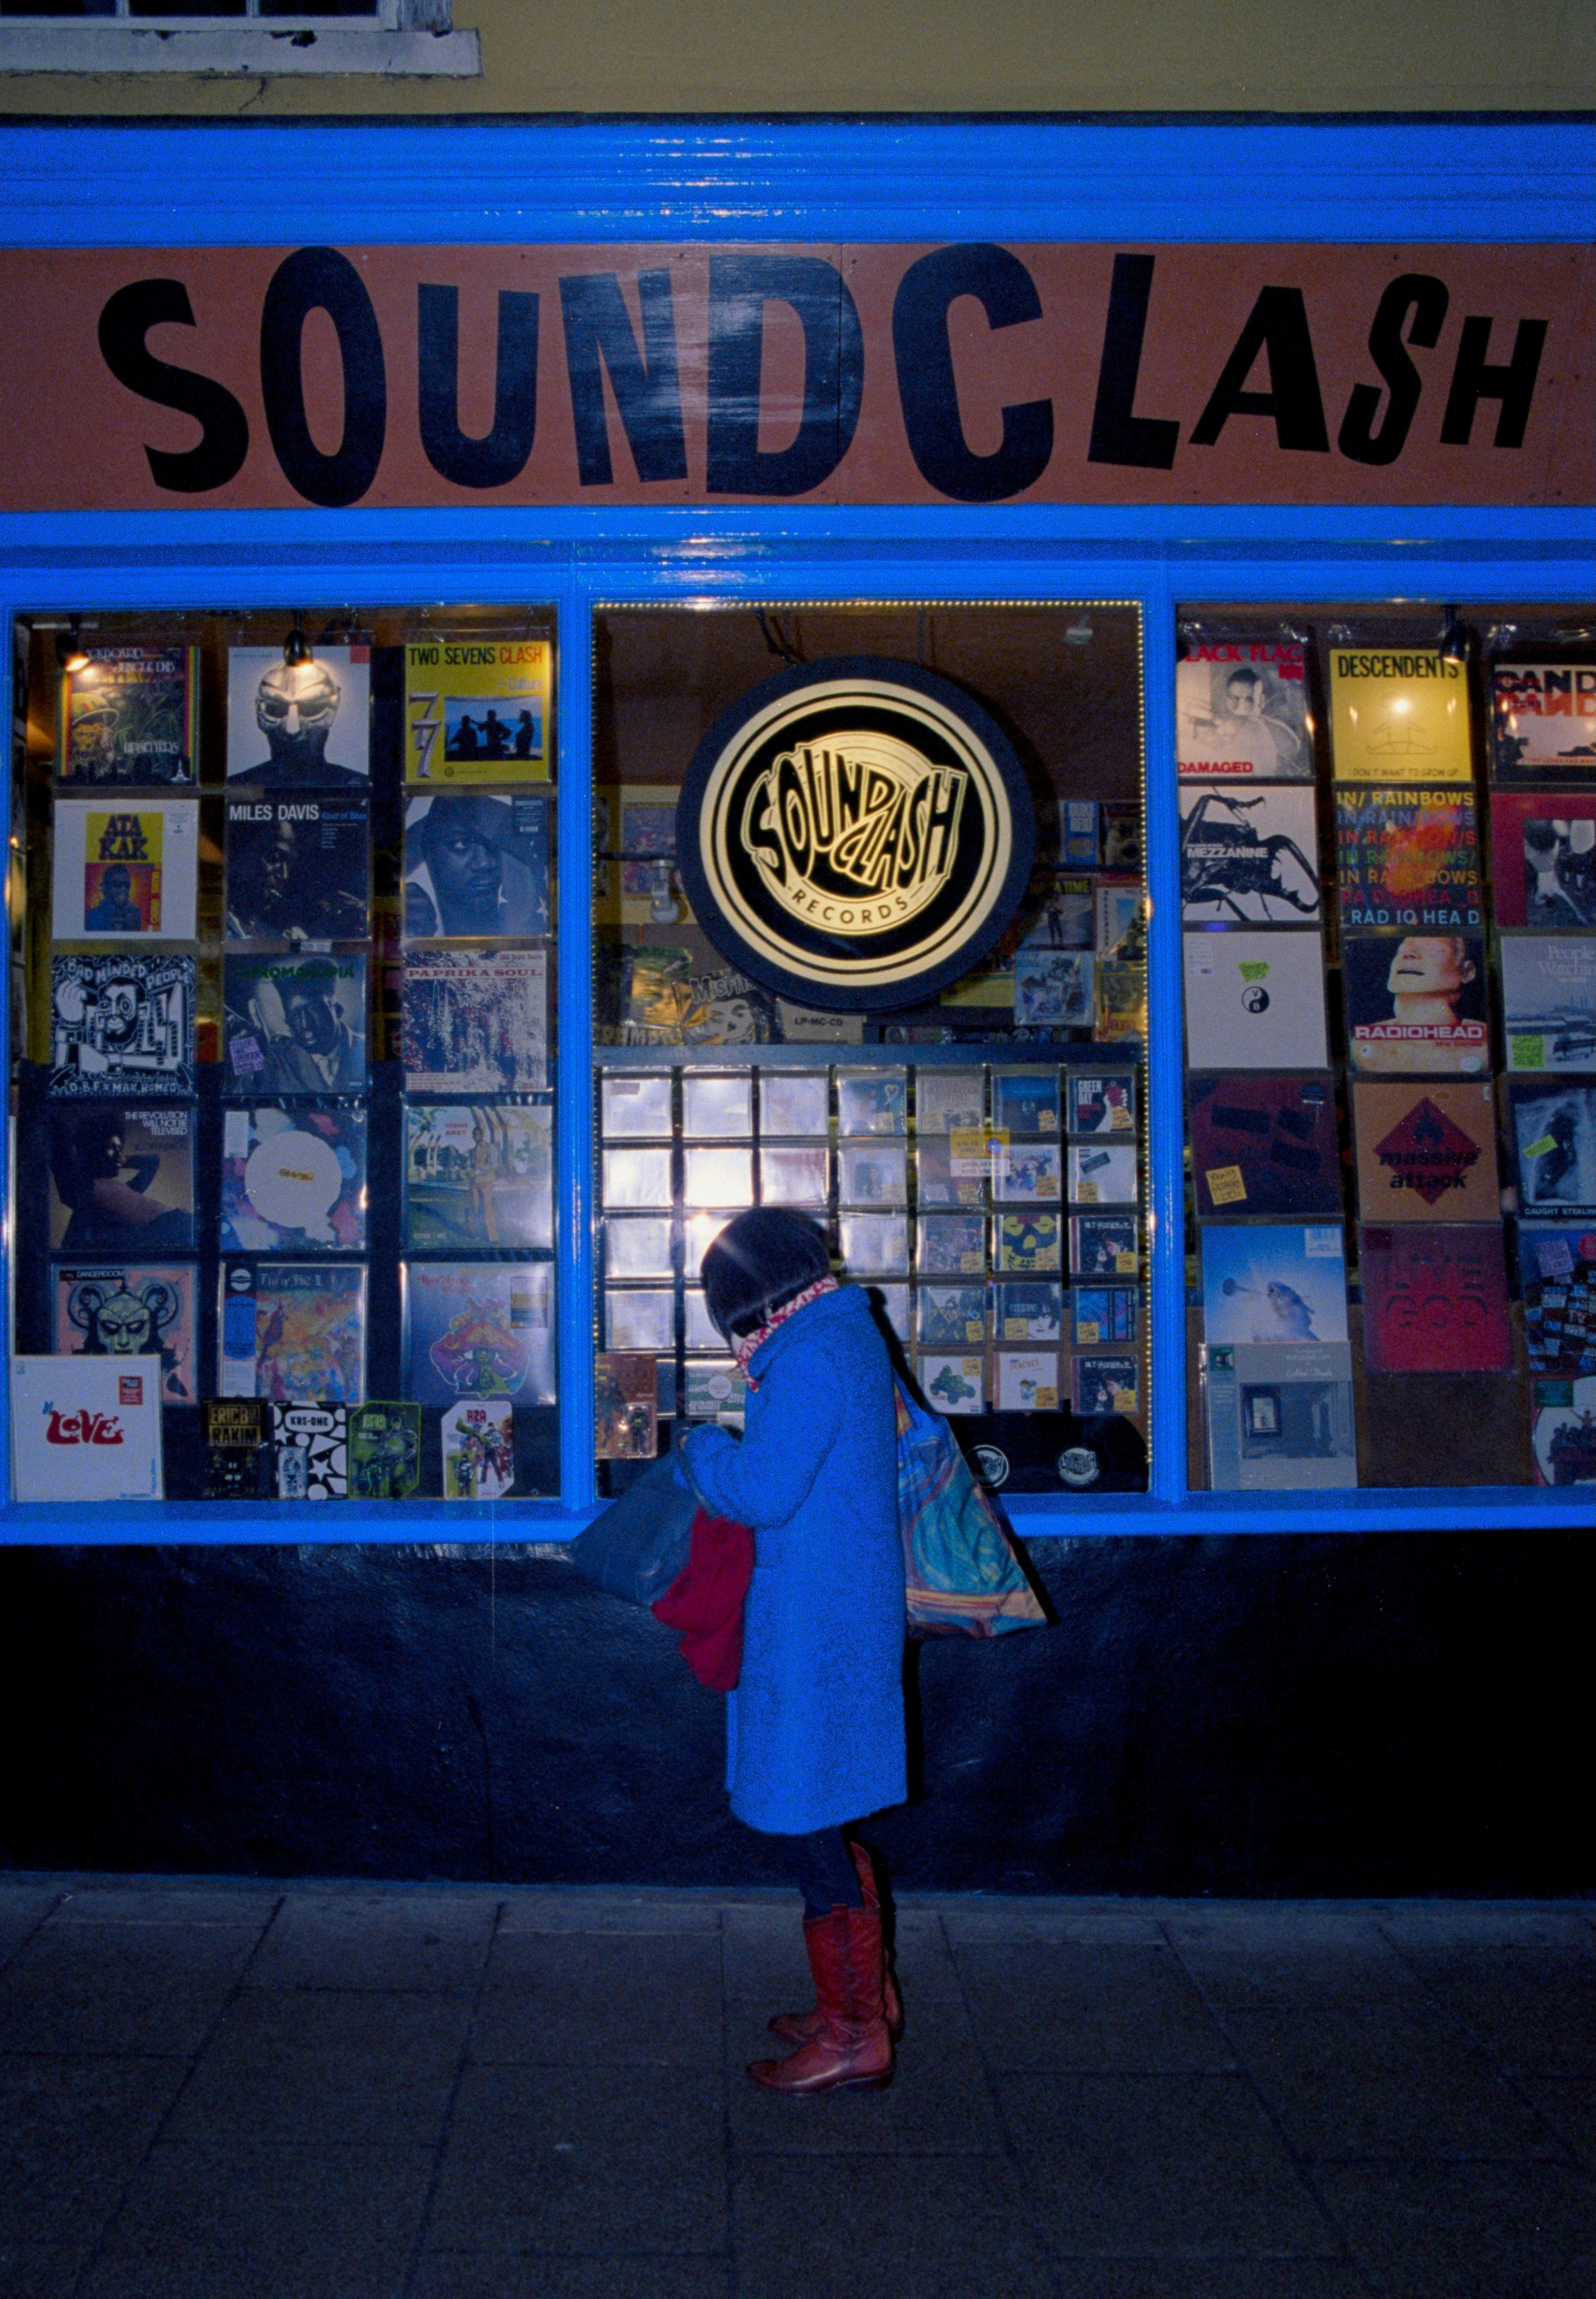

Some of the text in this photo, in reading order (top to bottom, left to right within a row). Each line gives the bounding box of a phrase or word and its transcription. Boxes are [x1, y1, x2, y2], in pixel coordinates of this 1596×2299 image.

[99, 243, 1549, 507] SOUNDCLASH
[409, 646, 542, 665] TWO SEVENS CLASH
[1185, 644, 1304, 662] LACK FLAG
[1339, 655, 1459, 679] DESCENDENTS
[411, 719, 441, 778] 7
[1178, 762, 1253, 774] DAMAGED
[1371, 791, 1475, 806] RAINBOWS
[229, 804, 367, 821] MILES DAVIS Kind of Blue
[1337, 811, 1358, 824] IN
[104, 814, 143, 837] ATA
[1338, 830, 1359, 844] IN
[98, 836, 149, 861] KAK
[1186, 847, 1270, 859] MEZZANINE
[1339, 850, 1359, 864] IN
[1340, 869, 1360, 884] IN
[791, 890, 909, 924] RECORDS
[1423, 910, 1460, 925] HEA
[1468, 910, 1479, 925] D
[67, 958, 190, 989] BAD MINDED PEOPLE
[409, 968, 542, 978] PAPRIKA SOUL
[1253, 1002, 1261, 1011] B
[795, 1017, 843, 1026] LP-MC-CD
[1355, 1026, 1483, 1041] RADIOHEAD
[1078, 1080, 1101, 1093] GREEN
[1078, 1092, 1092, 1104] DAY
[124, 1111, 188, 1120] THE REVOLUTION
[142, 1119, 159, 1128] WILL
[1380, 1150, 1478, 1167] massive
[1389, 1172, 1467, 1189] attack
[211, 1407, 238, 1425] ERIC
[291, 1416, 328, 1426] KRS-ONE
[467, 1410, 486, 1423] RZA
[46, 1409, 124, 1445] LOVE
[212, 1427, 257, 1444] RAKIM
